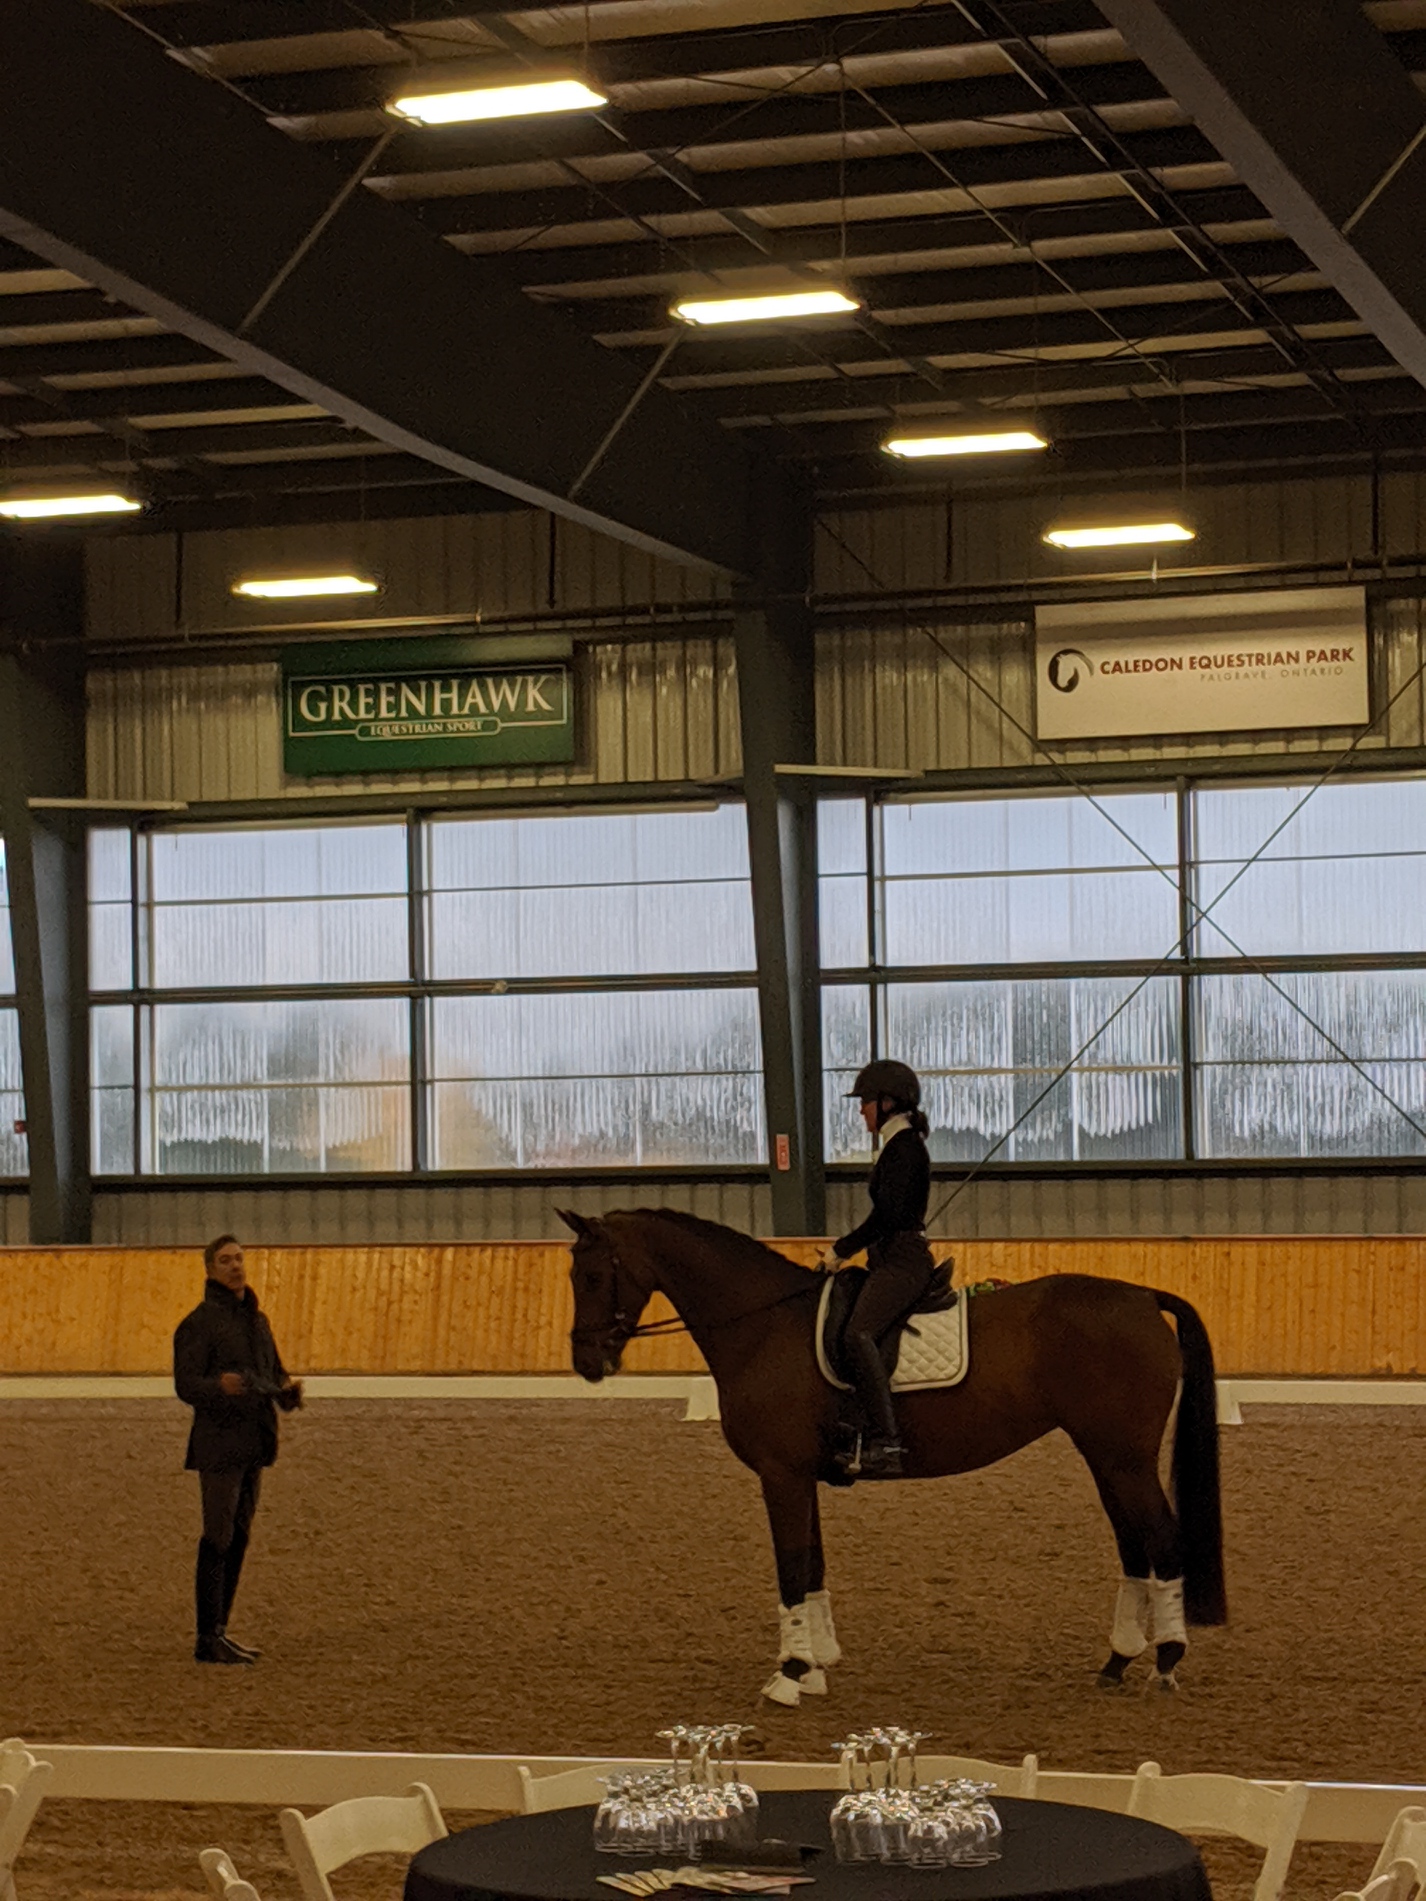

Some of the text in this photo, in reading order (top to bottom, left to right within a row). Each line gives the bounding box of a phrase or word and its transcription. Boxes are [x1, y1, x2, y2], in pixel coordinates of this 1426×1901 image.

[1100, 647, 1354, 675] CALEDON EQUESTRIAN PARK
[1281, 666, 1343, 678] ONTARIO
[300, 676, 555, 722] GREENHAWK
[371, 720, 483, 737] EQUESTRIAN SPORT
